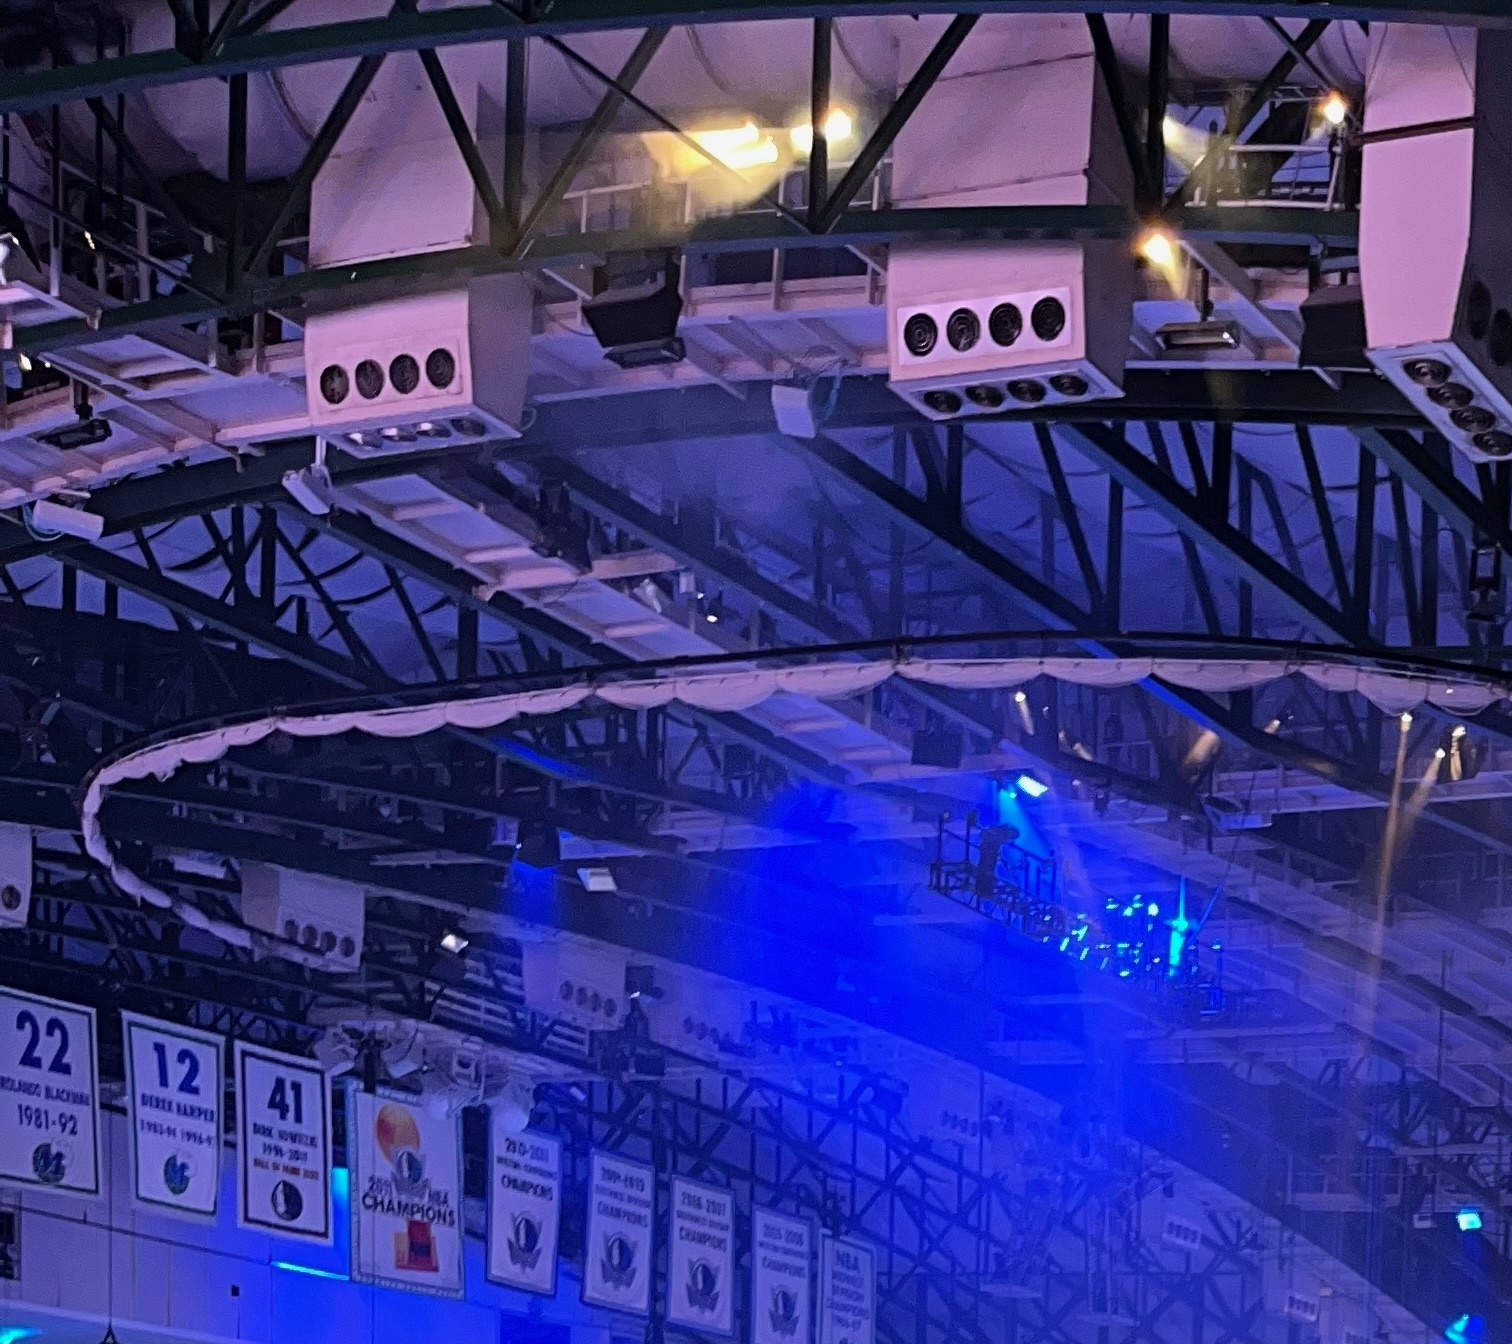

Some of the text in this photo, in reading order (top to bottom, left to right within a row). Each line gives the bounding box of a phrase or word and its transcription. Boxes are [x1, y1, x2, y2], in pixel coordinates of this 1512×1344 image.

[15, 1009, 73, 1076] 22
[153, 1042, 201, 1095] 12
[17, 1102, 78, 1136] 1981-92
[267, 1076, 303, 1124] 41
[361, 1192, 456, 1227] CHAMPIONS
